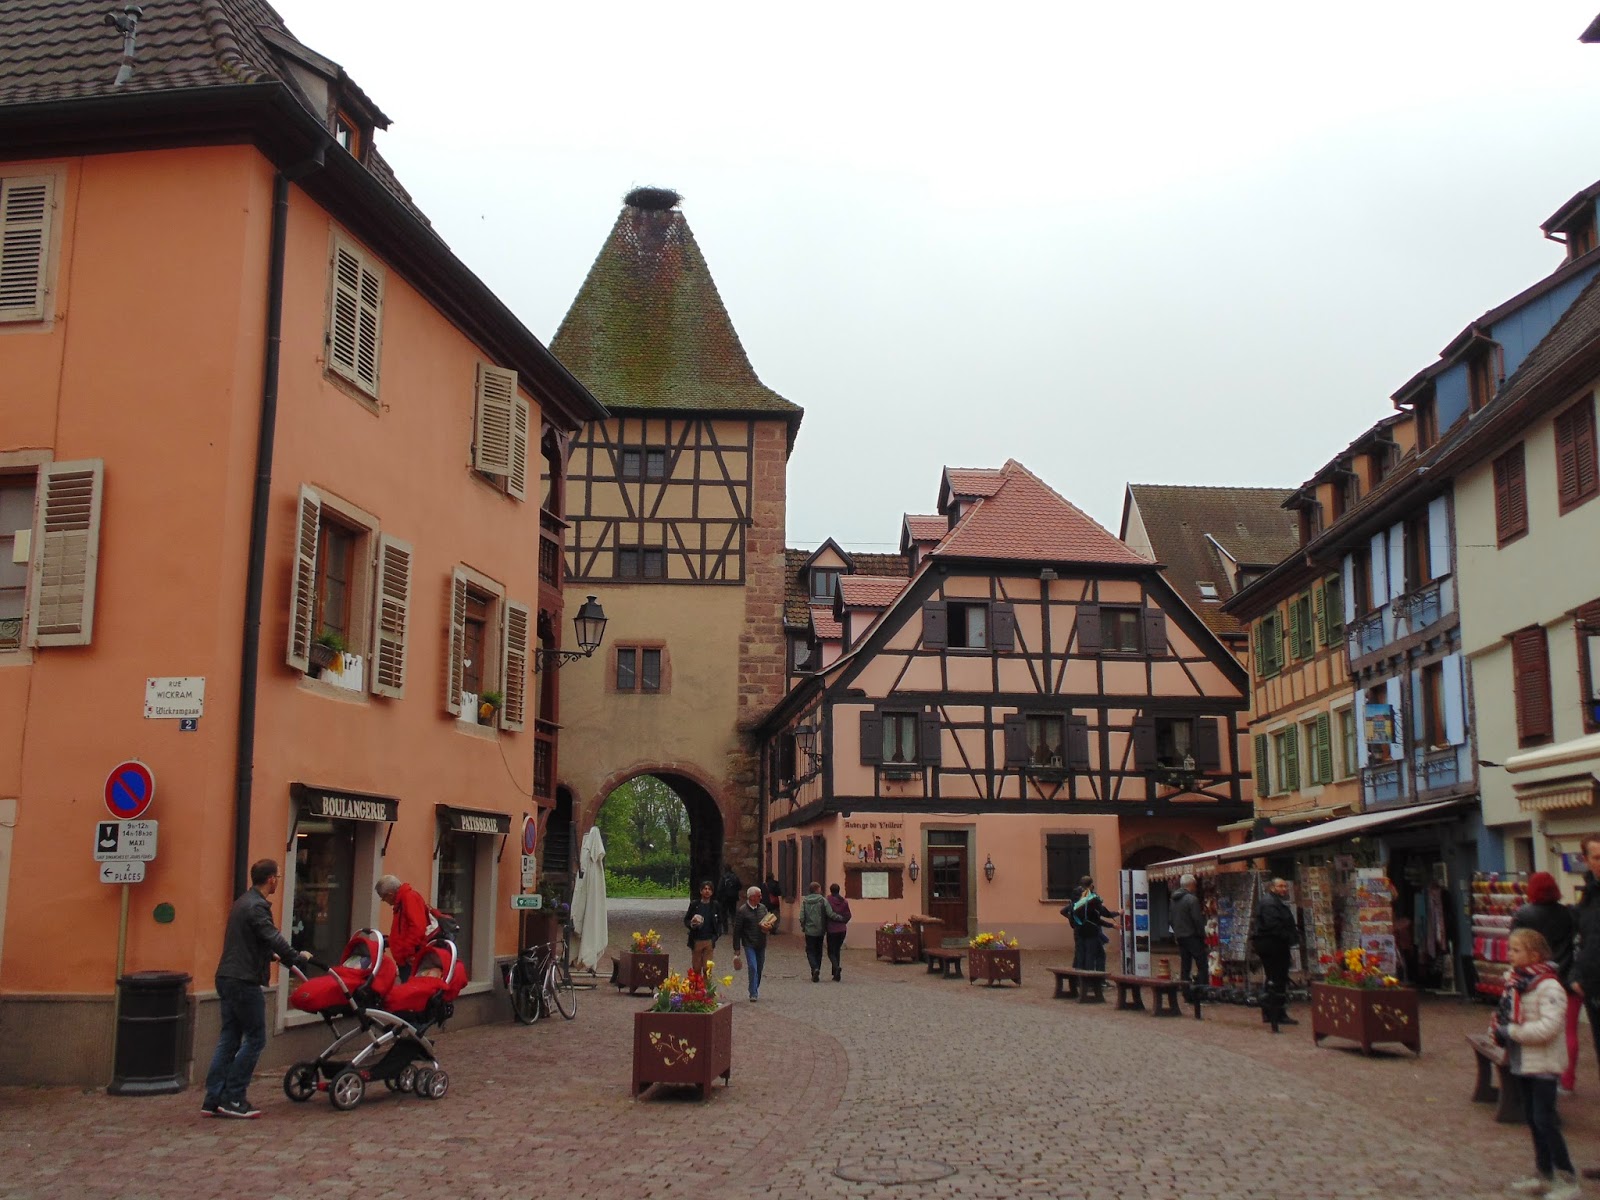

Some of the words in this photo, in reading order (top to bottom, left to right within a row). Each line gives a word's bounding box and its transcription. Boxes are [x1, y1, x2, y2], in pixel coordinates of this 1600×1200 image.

[157, 691, 193, 699] WICKRAM
[185, 719, 192, 729] 2
[322, 796, 387, 821] BOULANGERIE
[460, 815, 499, 833] PATISSERIE
[115, 873, 141, 881] PLACES
